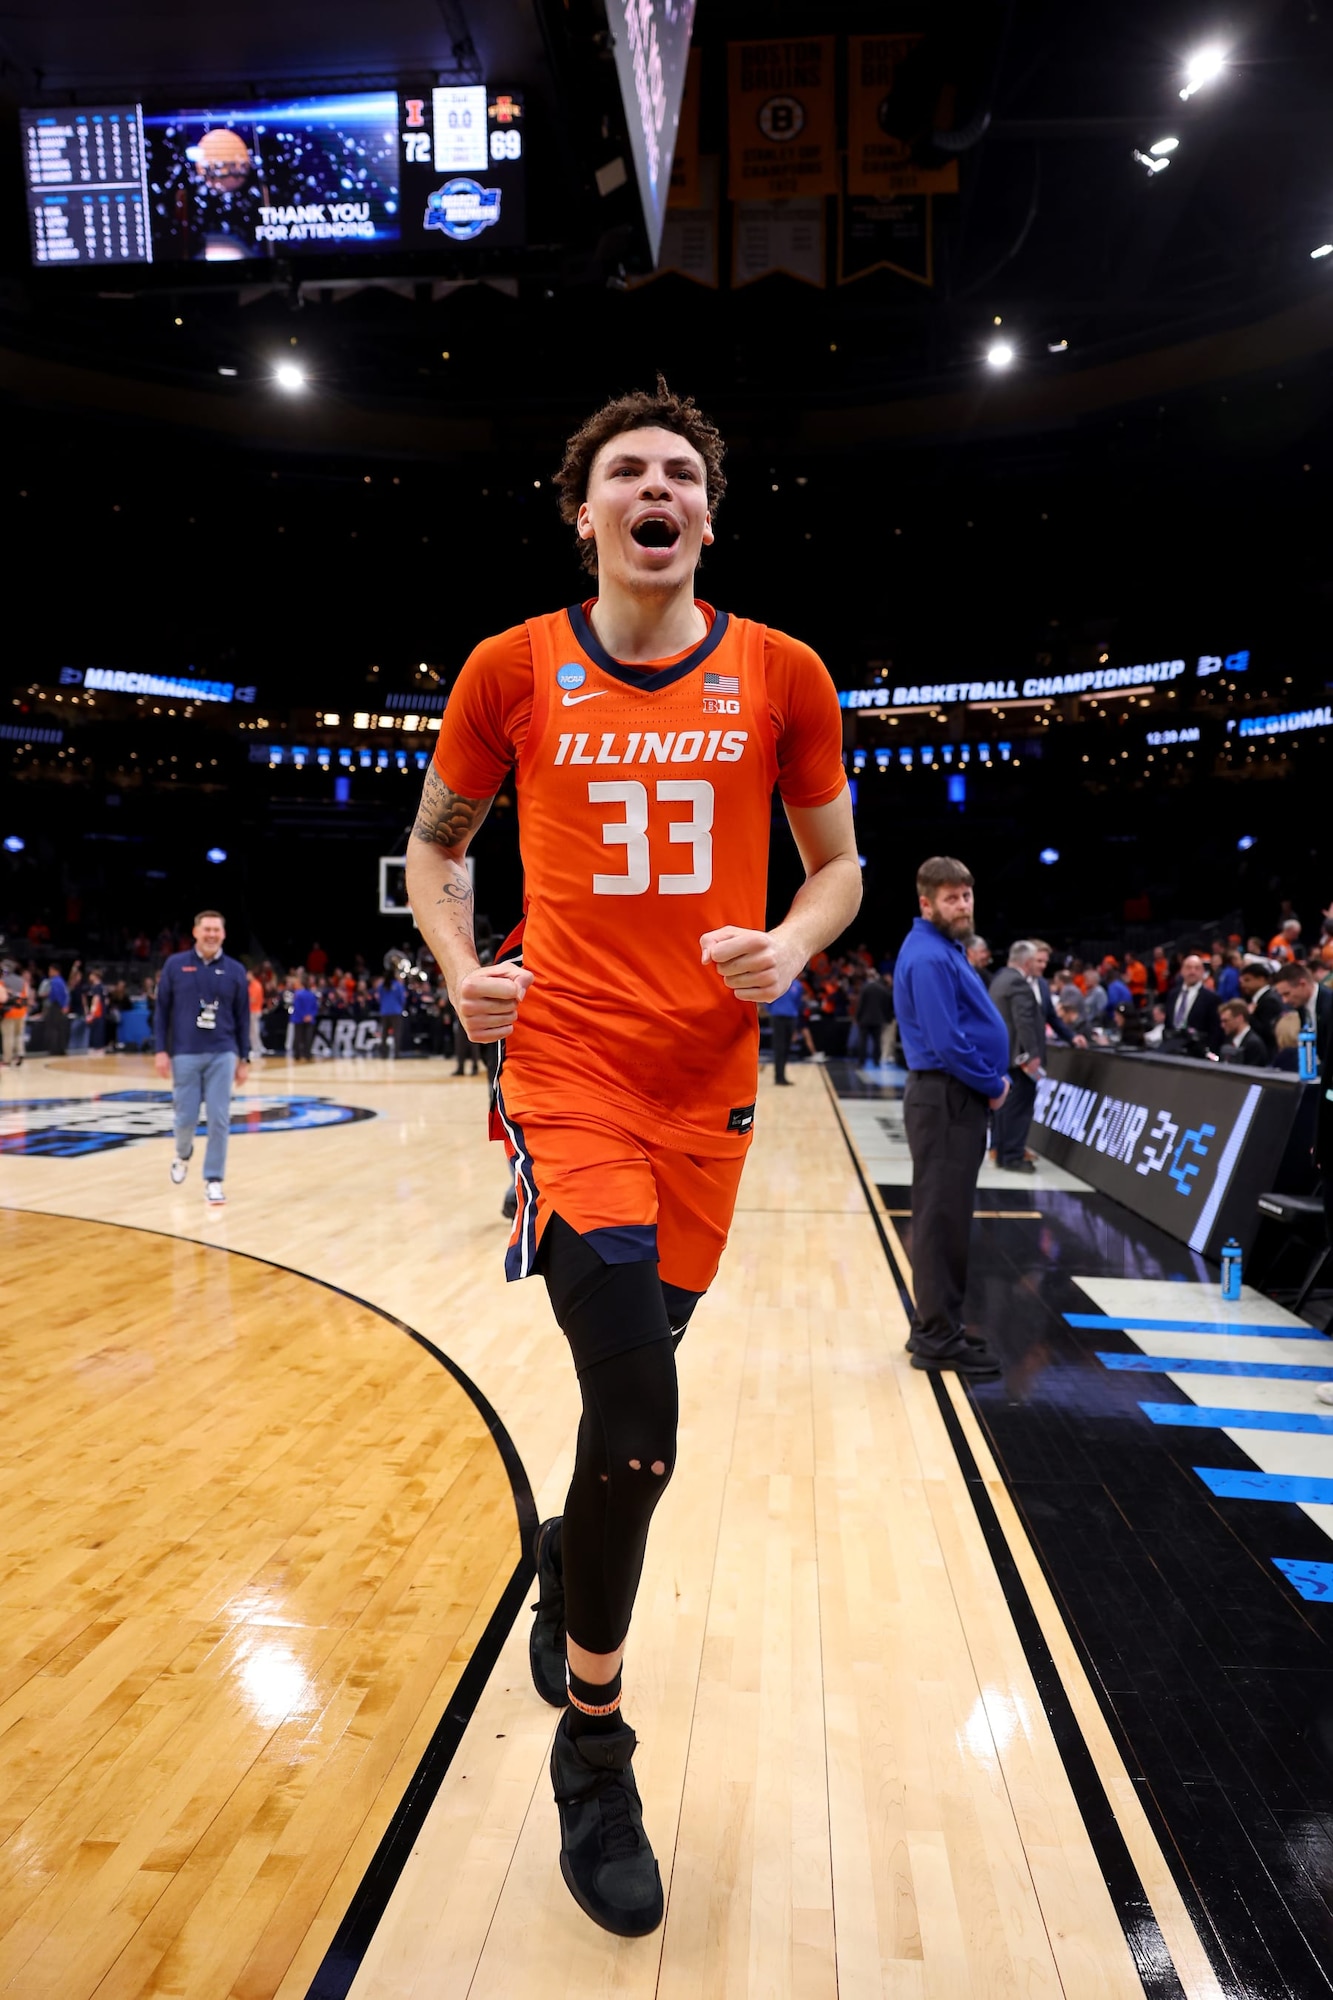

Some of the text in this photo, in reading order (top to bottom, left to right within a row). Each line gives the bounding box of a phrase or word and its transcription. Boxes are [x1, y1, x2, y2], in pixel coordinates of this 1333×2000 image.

[741, 43, 822, 66] BOSTON
[741, 65, 822, 91] BRUINS
[771, 105, 793, 132] B
[401, 131, 431, 163] 72
[490, 129, 522, 161] 69
[258, 201, 370, 225] THANK YOU
[255, 220, 376, 241] FOR ATTENDING
[559, 674, 585, 684] NCAA
[892, 680, 1018, 705] BASKETBALL
[1022, 659, 1186, 698] CHAMPIONSHIP
[1179, 727, 1201, 743] AM
[1239, 705, 1333, 737] REGIONAL
[553, 730, 749, 766] ILLINOIS
[587, 779, 715, 896] 33
[1045, 1081, 1099, 1143] FINAL
[1086, 1095, 1150, 1165] FOUR
